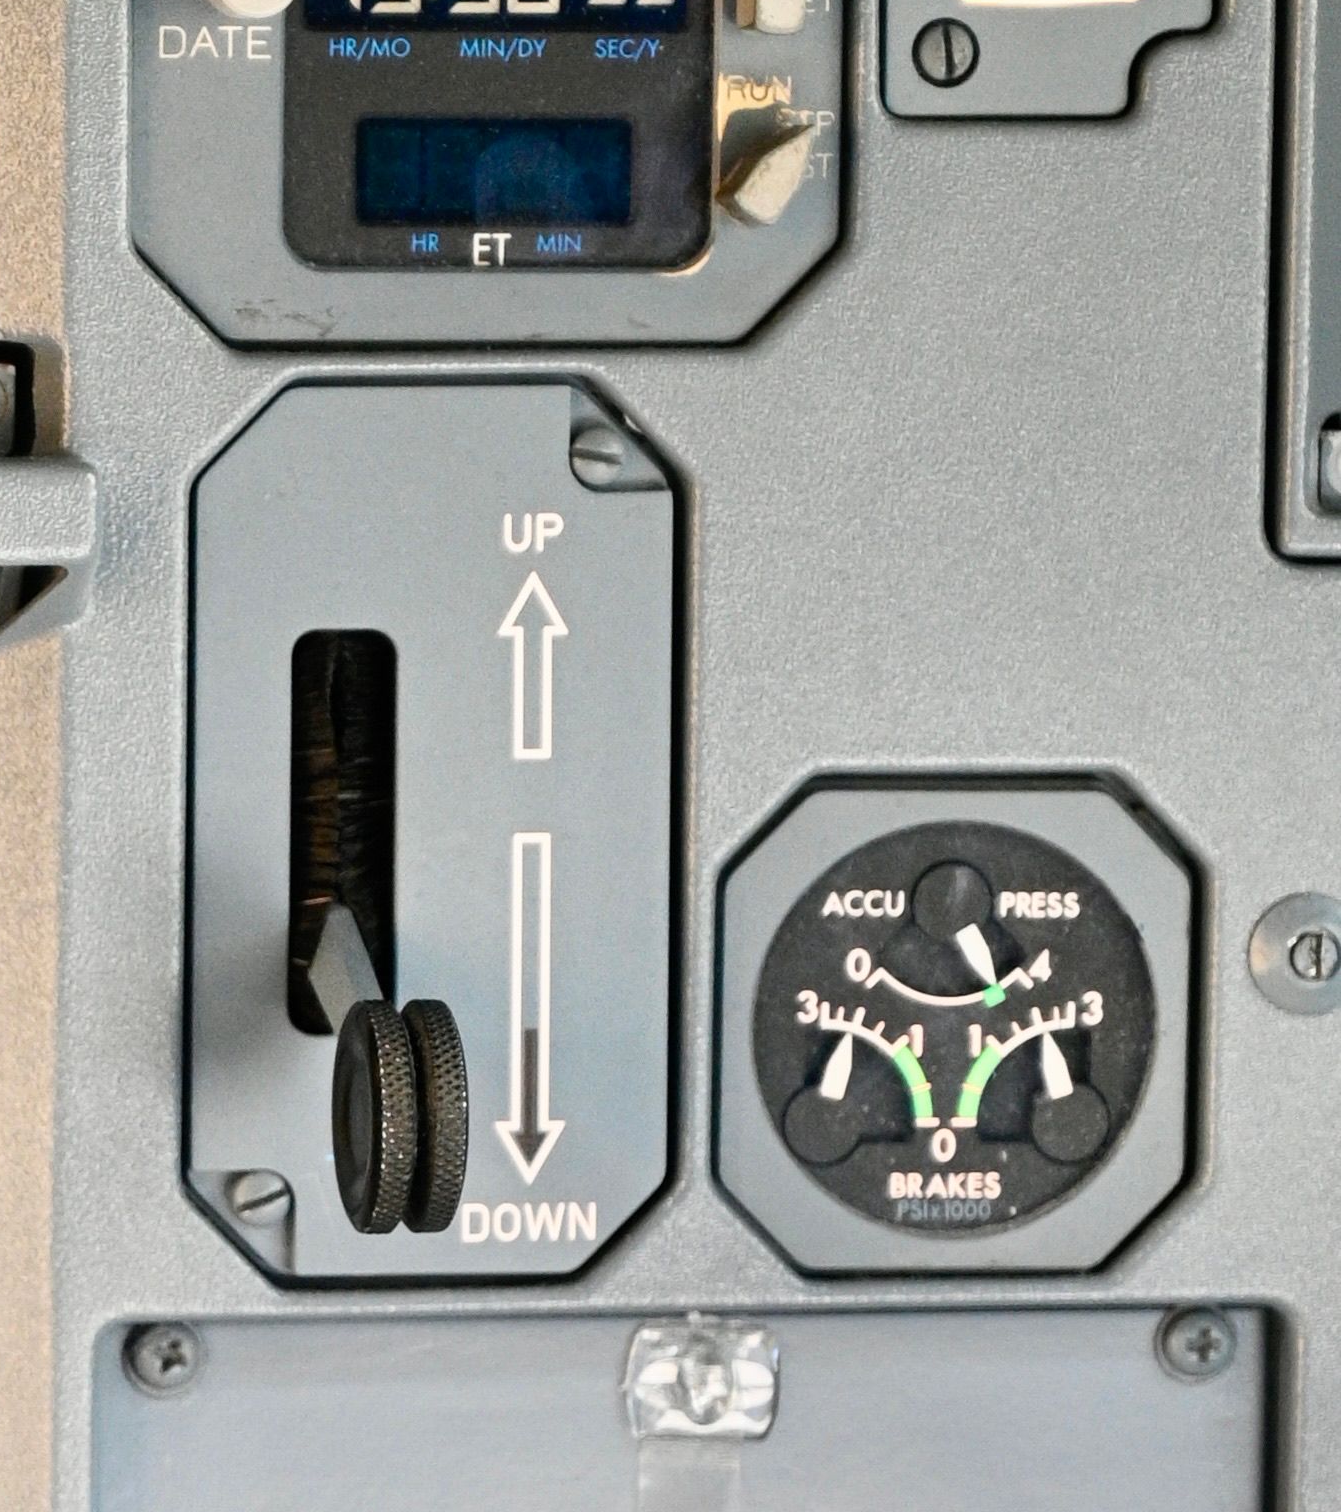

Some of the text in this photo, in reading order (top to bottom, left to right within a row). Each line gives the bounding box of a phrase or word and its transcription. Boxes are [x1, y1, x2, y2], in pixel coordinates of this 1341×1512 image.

[158, 25, 273, 61] DATE
[502, 512, 565, 554] UP
[821, 889, 1081, 919] ACCU PRESS
[888, 1171, 1002, 1200] BRAKES
[460, 1201, 597, 1244] DOWN
